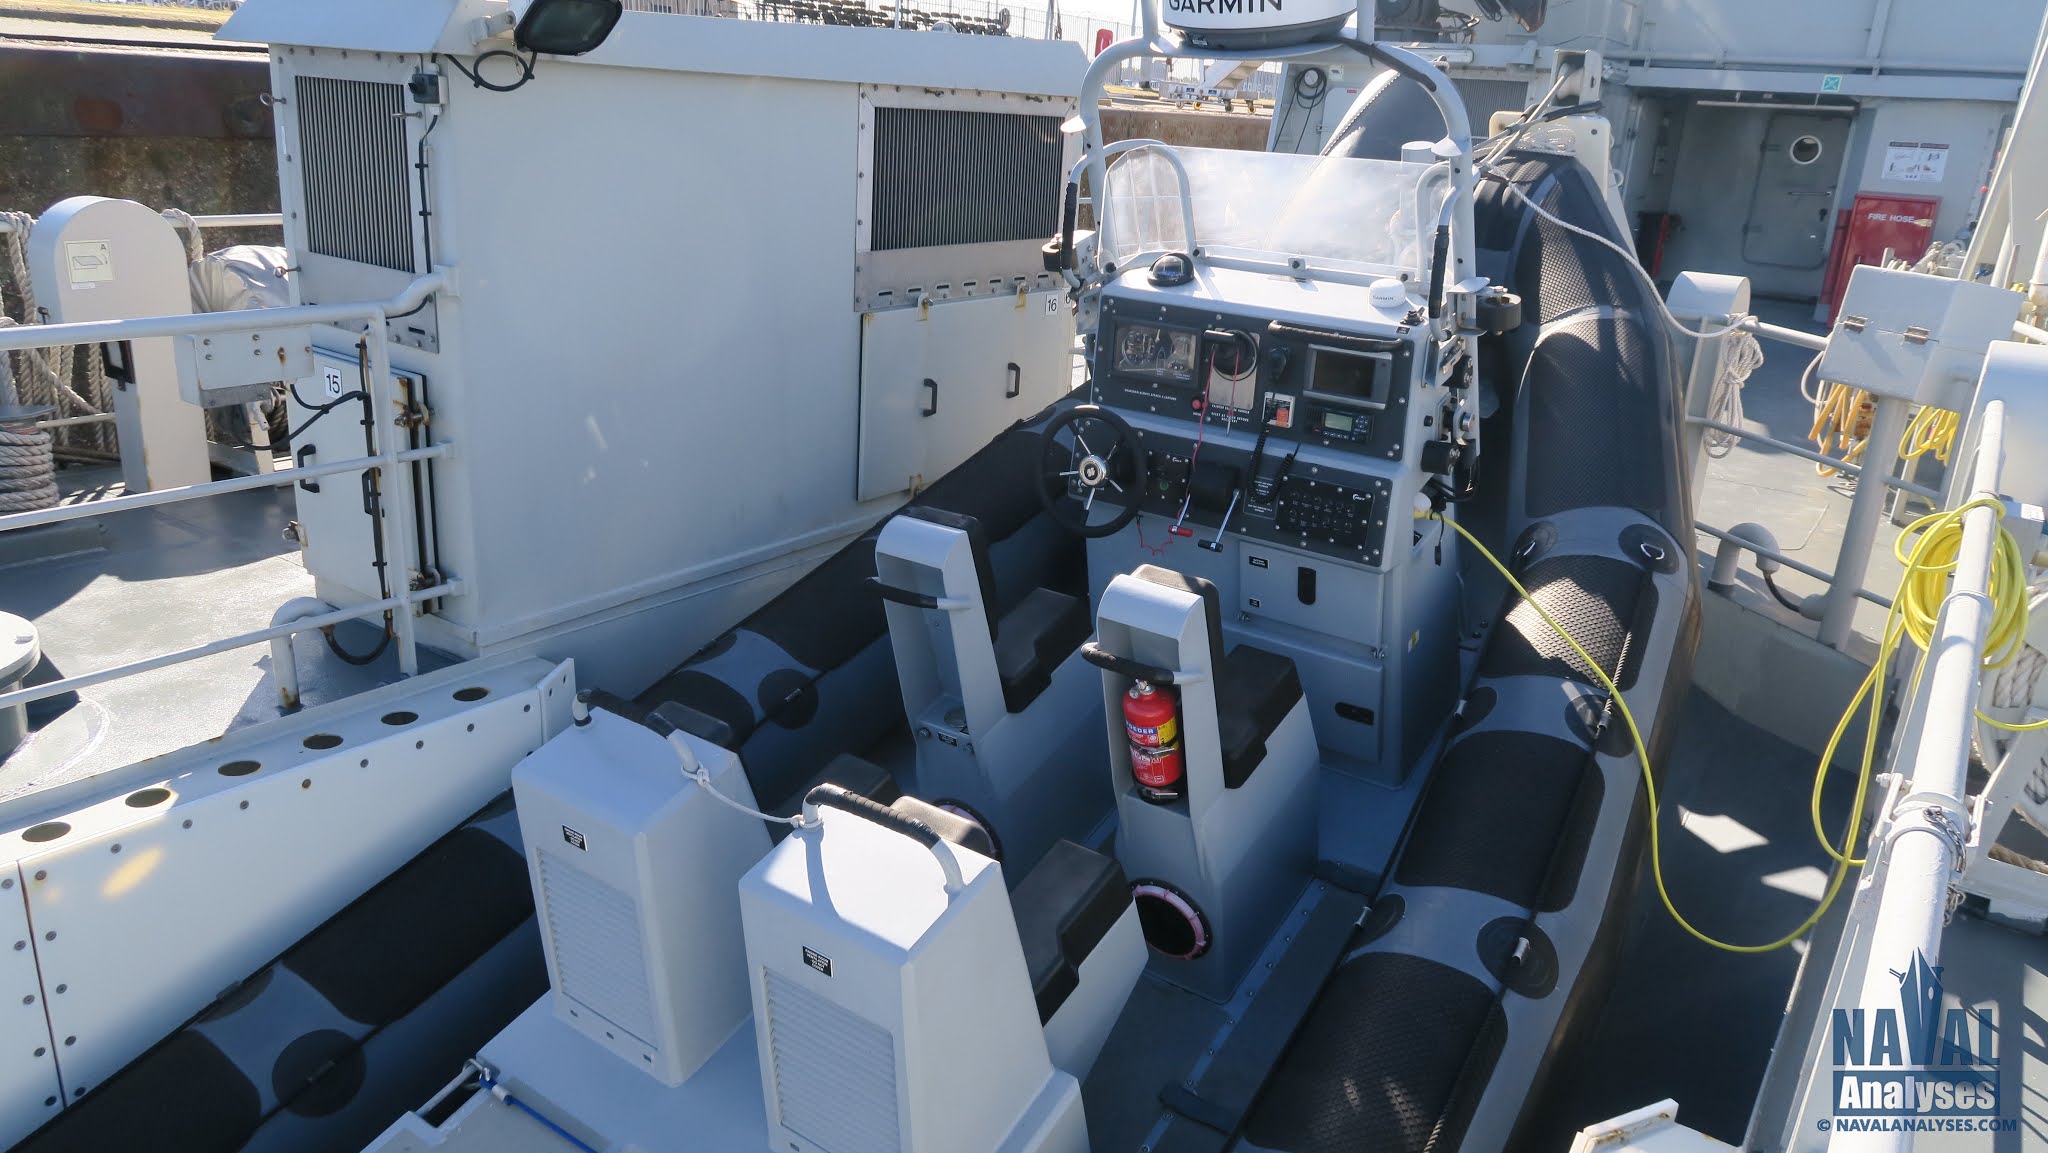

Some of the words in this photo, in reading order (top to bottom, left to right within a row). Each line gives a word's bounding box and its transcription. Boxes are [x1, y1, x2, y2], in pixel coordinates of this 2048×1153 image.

[1169, 0, 1282, 14] GARMIN
[1867, 212, 1887, 221] FIRE
[1889, 214, 1915, 223] HOSE
[100, 243, 107, 251] A
[1047, 298, 1057, 312] 16
[325, 373, 340, 394] 15
